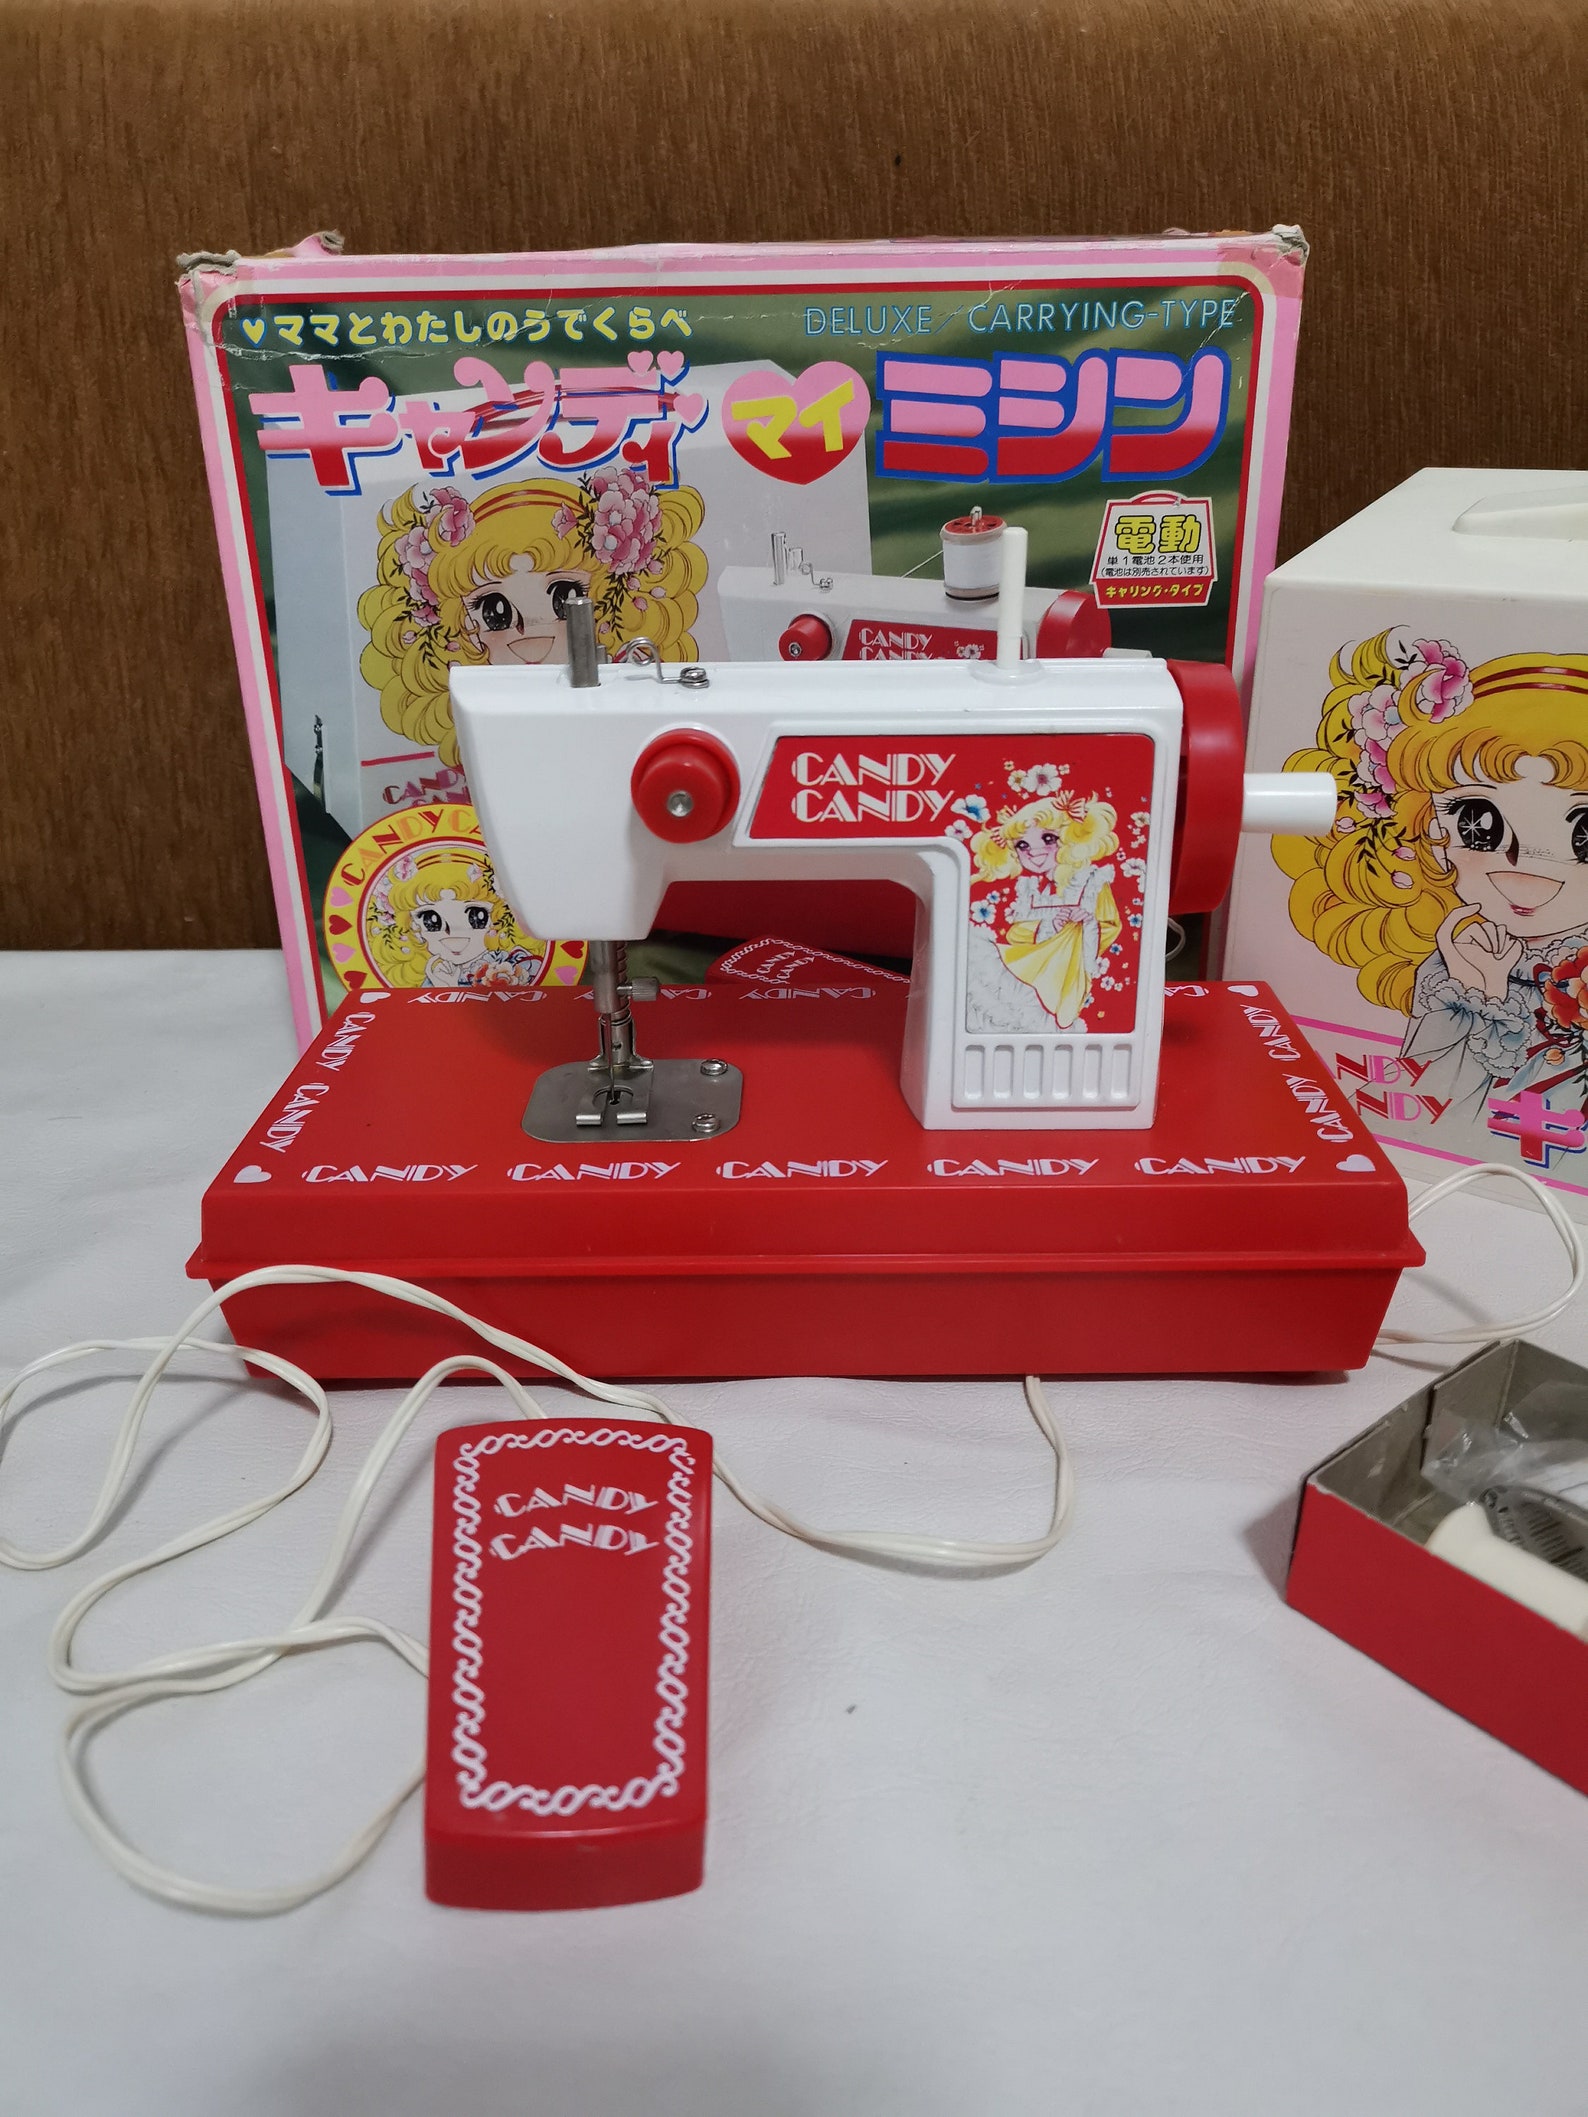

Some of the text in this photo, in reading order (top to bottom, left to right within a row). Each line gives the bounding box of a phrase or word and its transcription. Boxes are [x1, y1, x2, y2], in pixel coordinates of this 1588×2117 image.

[273, 307, 693, 345] ママとわたしのうでくらべ
[804, 306, 933, 336] DELUXE
[966, 299, 1236, 333] CARRYING-TYPE
[248, 346, 1232, 496] キャンディ マイ ミシン
[1114, 514, 1202, 555] 電動
[858, 627, 933, 651] CANDY
[791, 752, 957, 786] CANDY
[791, 789, 955, 822] CANDY
[757, 950, 796, 974] CANDY
[776, 956, 815, 980] CANDY
[407, 991, 548, 1003] CANDY
[738, 986, 877, 1000] CANDY
[315, 1011, 376, 1072] CANDY
[1239, 1004, 1301, 1062] CANDY
[1335, 1052, 1432, 1087] NDY
[259, 1082, 330, 1154] CANDY
[1282, 1073, 1354, 1143] CANDY
[1356, 1089, 1453, 1124] NDY
[301, 1155, 1306, 1184] CANDY CANDY CANDY CANDY CANDY
[494, 1483, 659, 1518] CANDY
[489, 1523, 660, 1561] CANDY
